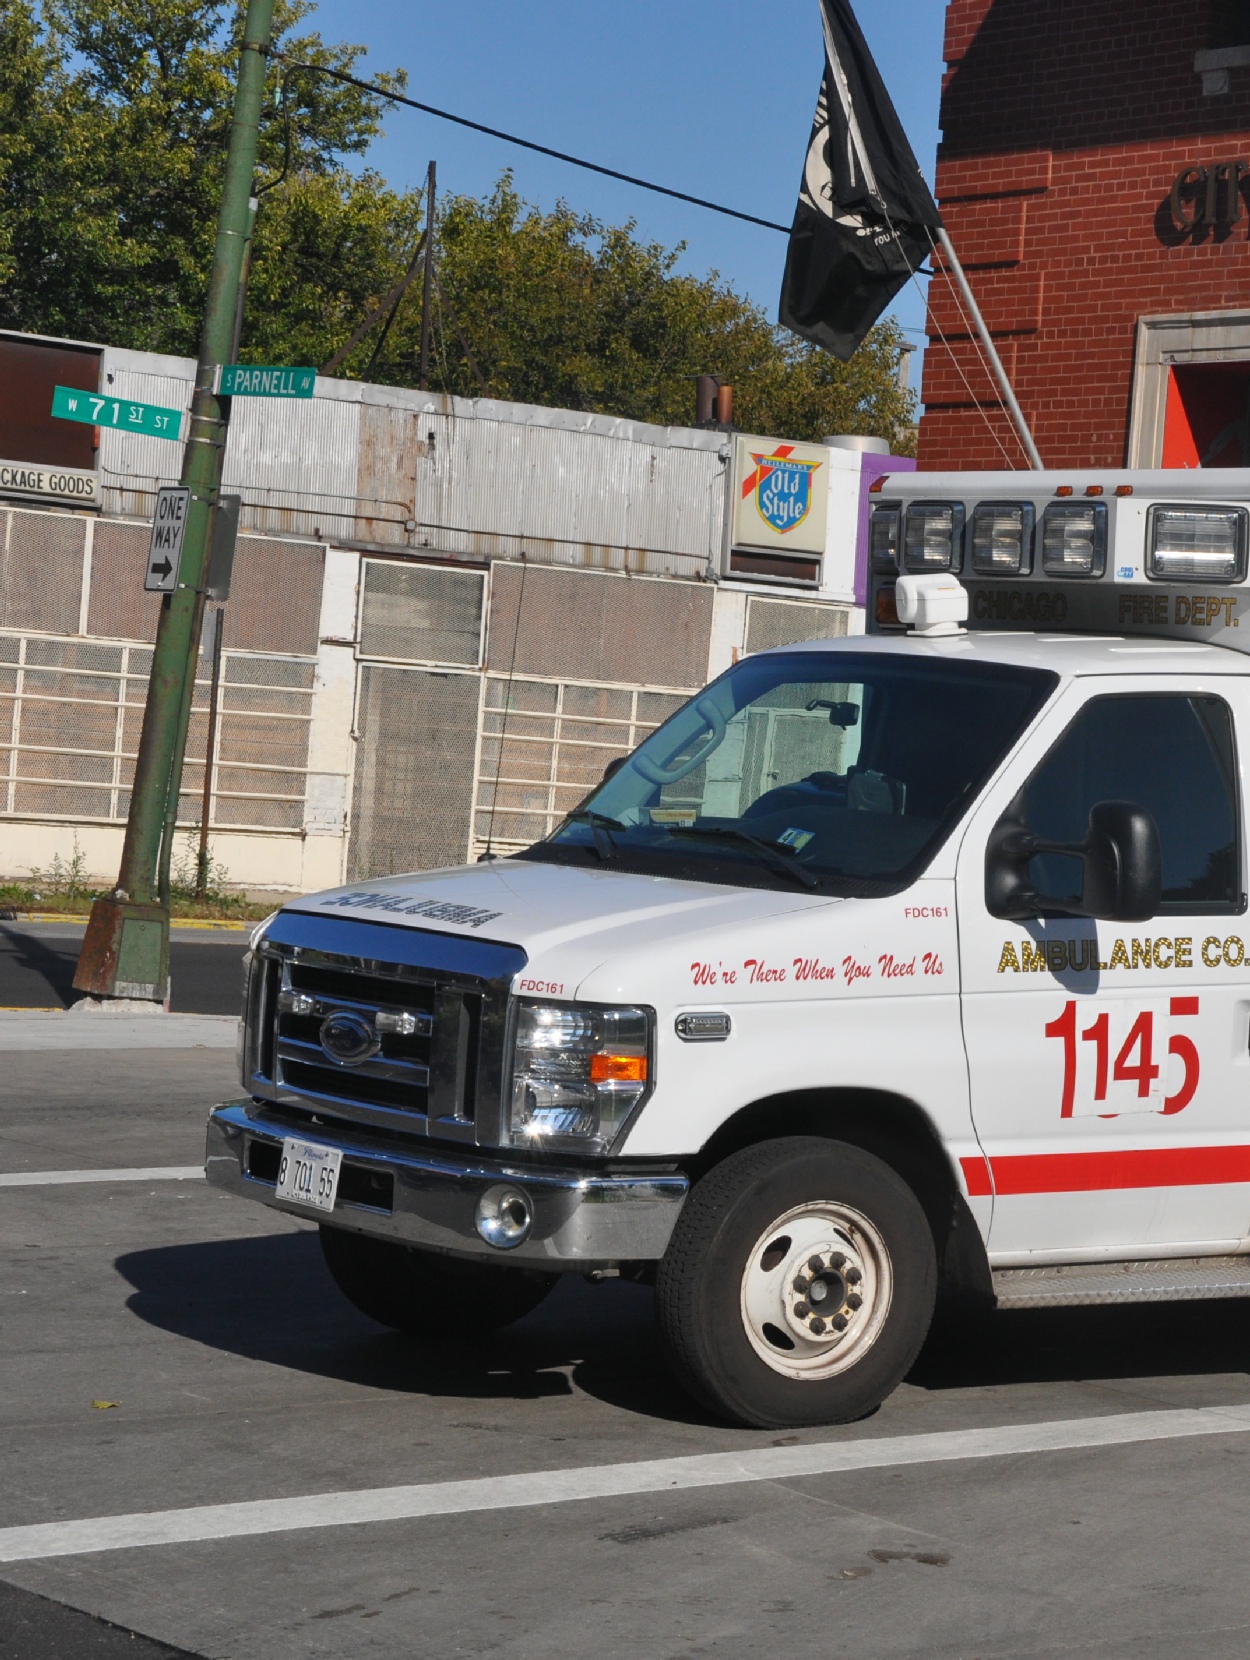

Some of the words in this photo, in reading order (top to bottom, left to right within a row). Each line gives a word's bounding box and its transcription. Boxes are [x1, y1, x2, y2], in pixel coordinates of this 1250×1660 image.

[226, 375, 233, 388] S
[234, 369, 296, 394] PARNELL
[300, 376, 311, 389] AV
[68, 399, 77, 412] W
[89, 397, 119, 424] 71
[153, 415, 169, 430] ST
[1, 467, 44, 489] CKAGE
[49, 474, 94, 495] GOODS
[771, 470, 799, 494] Old
[159, 495, 183, 522] ONE
[762, 489, 803, 525] Style
[154, 523, 182, 550] WAY
[972, 590, 1068, 623] CHICAGO
[1118, 594, 1169, 624] FIRE
[1175, 595, 1239, 628] DEPT.
[904, 907, 949, 919] FDC161
[690, 961, 737, 986] We're
[743, 959, 787, 984] There
[793, 957, 836, 981] When
[842, 955, 872, 987] You
[878, 953, 916, 978] Need
[922, 951, 944, 976] Us
[997, 937, 1193, 974] AMBULANCE
[519, 979, 564, 995] FDC161
[279, 1156, 288, 1186] 8
[293, 1160, 313, 1193] 701
[318, 1167, 335, 1199] 55
